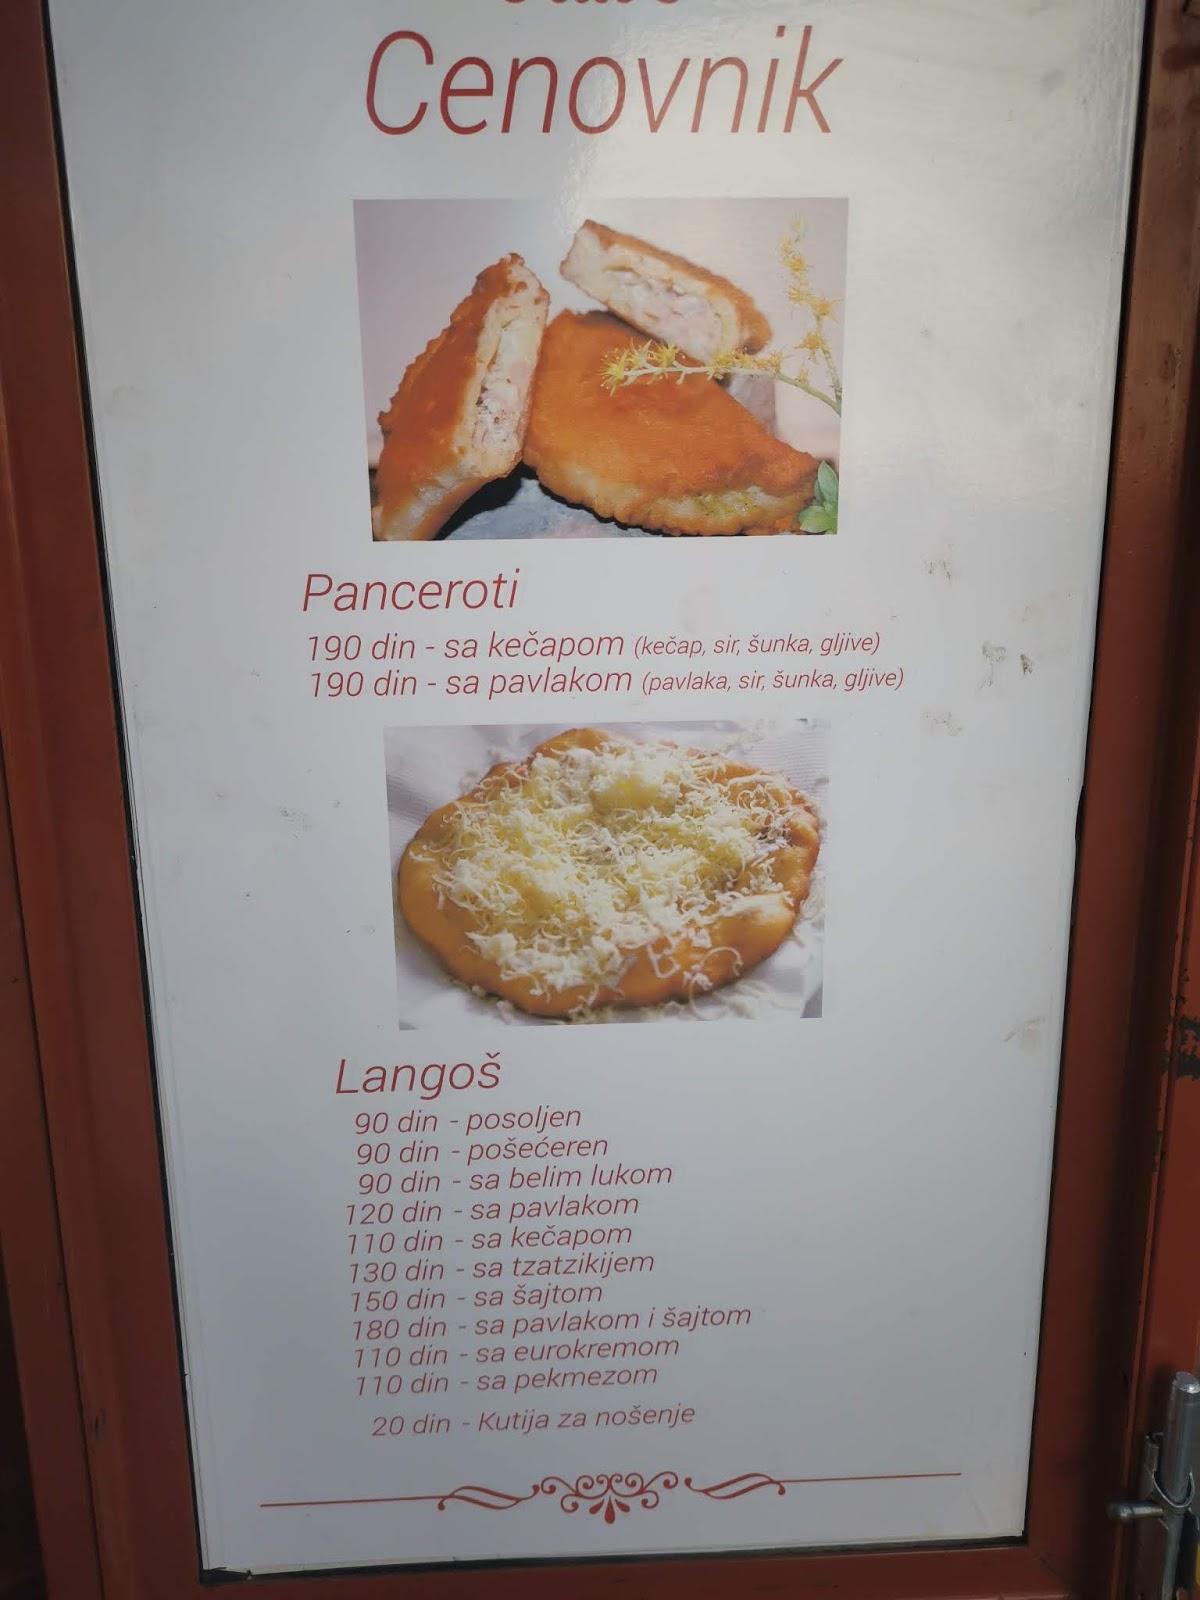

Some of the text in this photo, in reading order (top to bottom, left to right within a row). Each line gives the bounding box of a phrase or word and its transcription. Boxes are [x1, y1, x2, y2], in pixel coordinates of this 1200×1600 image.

[366, 25, 844, 135] Cenovnik
[303, 568, 520, 612] Panceroti
[309, 635, 361, 661] 190
[372, 633, 415, 659] din
[444, 638, 478, 658] sa
[488, 631, 624, 662] kečapom
[634, 636, 706, 660] (kečap,
[713, 635, 740, 654] sir,
[748, 633, 812, 655] šunka,
[820, 632, 880, 656] gljive)
[311, 671, 363, 697] 190
[374, 669, 417, 696] din
[446, 674, 479, 695] sa
[489, 666, 632, 700] pavlakom
[642, 671, 731, 695] (pavlaka,
[739, 671, 765, 690] sir,
[772, 669, 837, 690] šunka,
[844, 667, 904, 691] gljive)
[335, 1052, 501, 1101] Langoš
[355, 1112, 388, 1135] 90
[398, 1110, 438, 1133] din
[466, 1105, 582, 1136] posoljen
[357, 1143, 390, 1165] 90
[399, 1140, 439, 1163] din
[468, 1137, 608, 1166] pošećeren
[359, 1173, 392, 1195] 90
[401, 1171, 440, 1193] din
[469, 1173, 500, 1190] sa
[509, 1167, 581, 1189] belim
[591, 1163, 672, 1187] lukom
[346, 1203, 393, 1225] 120
[402, 1200, 442, 1223] din
[470, 1202, 501, 1220] sa
[509, 1194, 639, 1223] pavlakom
[347, 1232, 395, 1255] 110
[403, 1230, 443, 1253] din
[471, 1232, 501, 1249] sa
[511, 1225, 632, 1251] kečapom
[349, 1261, 396, 1283] 130
[405, 1258, 444, 1281] din
[472, 1261, 502, 1278] sa
[512, 1252, 654, 1279] tzatzikijem
[351, 1290, 398, 1312] 150
[406, 1287, 445, 1310] din
[473, 1290, 503, 1307] sa
[512, 1284, 602, 1309] šajtom
[352, 1319, 399, 1341] 180
[408, 1316, 447, 1338] din
[474, 1318, 504, 1336] sa
[512, 1311, 639, 1339] pavlakom
[648, 1307, 655, 1329] i
[662, 1305, 751, 1332] šajtom
[354, 1347, 400, 1369] 110
[409, 1344, 448, 1366] din
[475, 1346, 505, 1364] sa
[514, 1338, 680, 1363] eurokremom
[356, 1374, 401, 1396] 110
[410, 1371, 448, 1394] din
[476, 1374, 506, 1391] sa
[514, 1366, 657, 1393] pekmezom
[372, 1416, 404, 1437] 20
[413, 1413, 450, 1435] din
[478, 1411, 549, 1433] Kutija
[557, 1411, 587, 1428] za
[595, 1402, 695, 1428] nošenje
